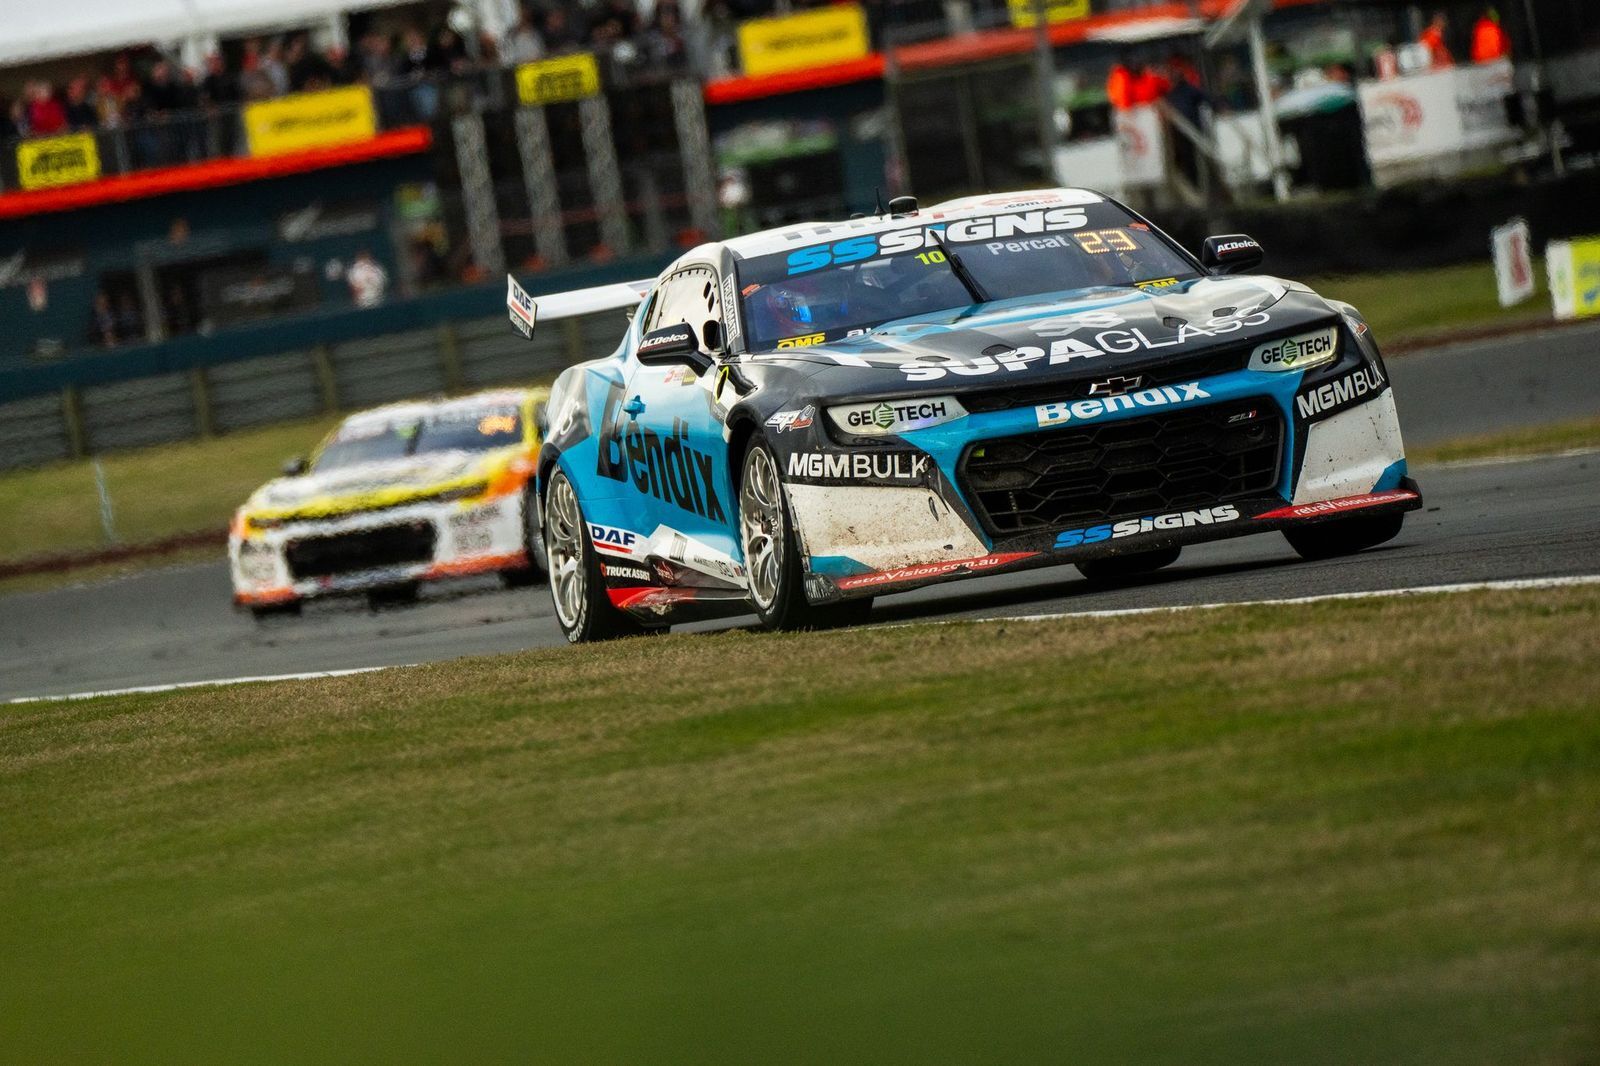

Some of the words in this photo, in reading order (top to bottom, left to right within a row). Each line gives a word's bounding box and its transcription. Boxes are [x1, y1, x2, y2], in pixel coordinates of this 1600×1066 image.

[986, 234, 1070, 255] Percat
[1073, 229, 1137, 255] 23
[914, 250, 946, 265] 10
[513, 283, 532, 312] DAF
[640, 333, 689, 348] ACDelco
[1035, 382, 1211, 428] Bendix
[596, 380, 727, 526] Bendix
[592, 526, 635, 546] DAF
